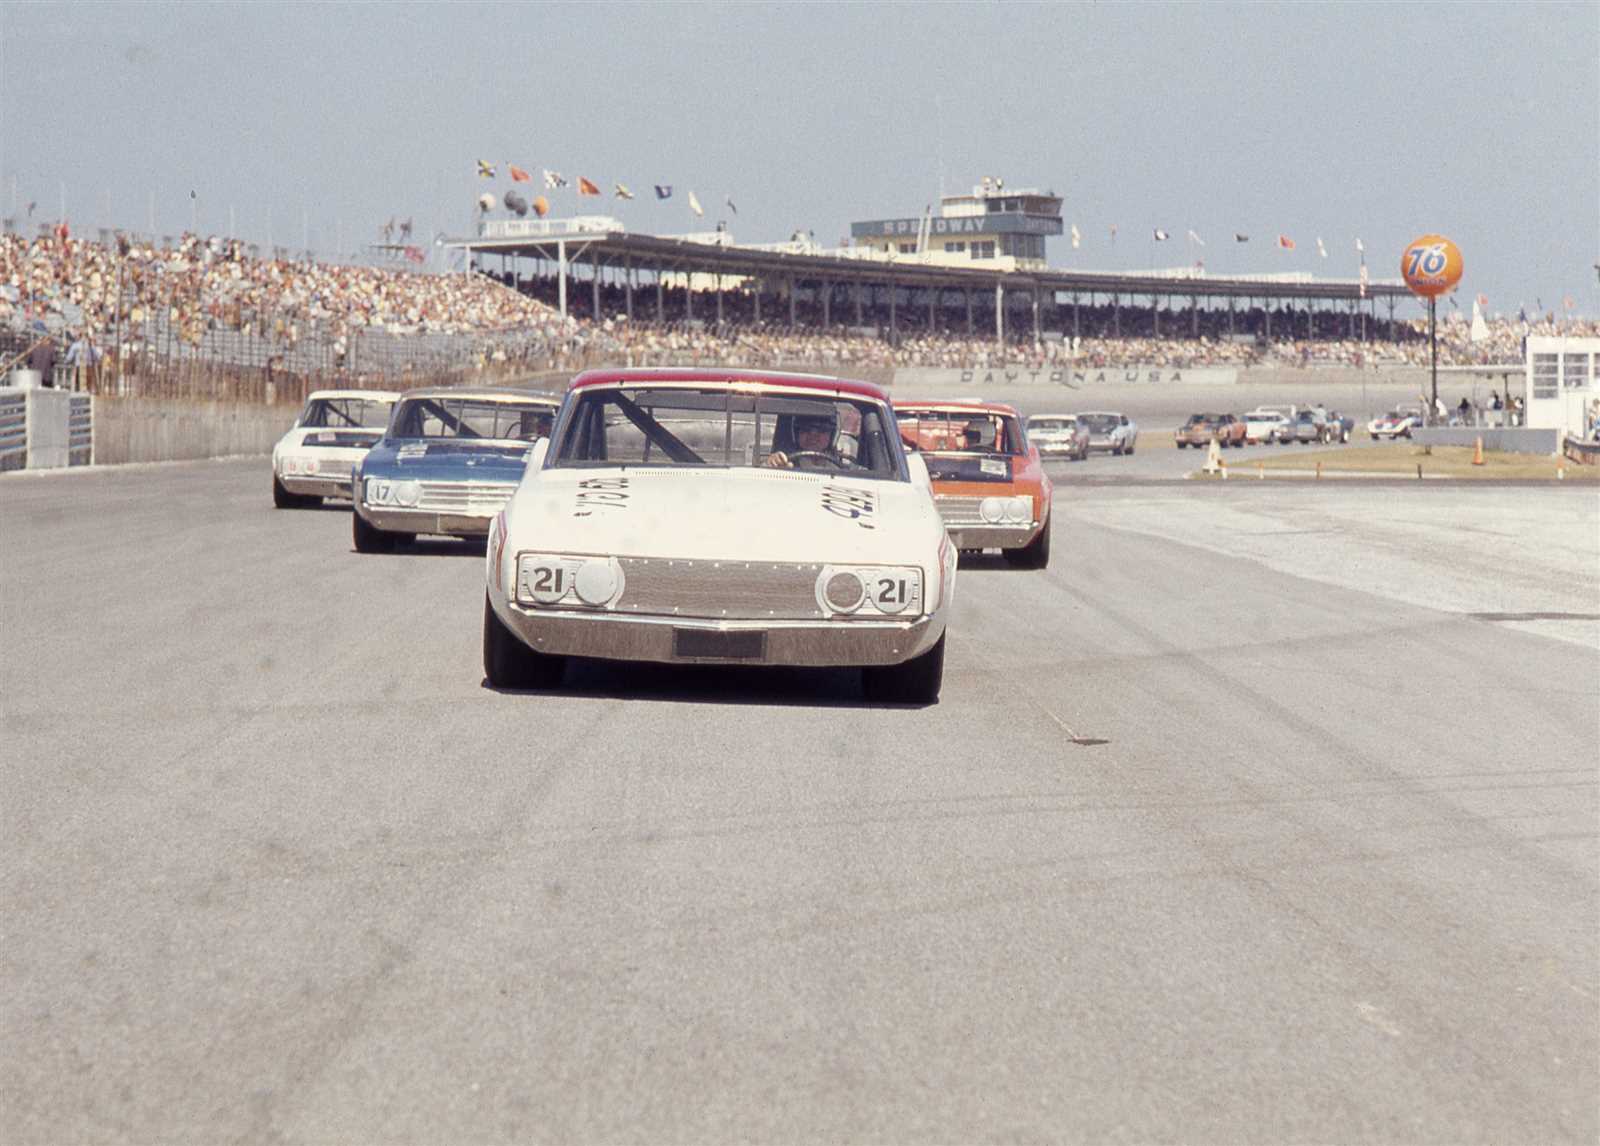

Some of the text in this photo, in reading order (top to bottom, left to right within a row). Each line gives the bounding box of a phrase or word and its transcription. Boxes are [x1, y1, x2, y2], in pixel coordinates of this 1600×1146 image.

[884, 218, 985, 235] SPEDWAY
[1407, 242, 1448, 276] 76
[960, 370, 1182, 384] DAYTONA USA
[375, 486, 390, 500] 17
[533, 566, 563, 593] 21
[878, 578, 906, 603] 21
